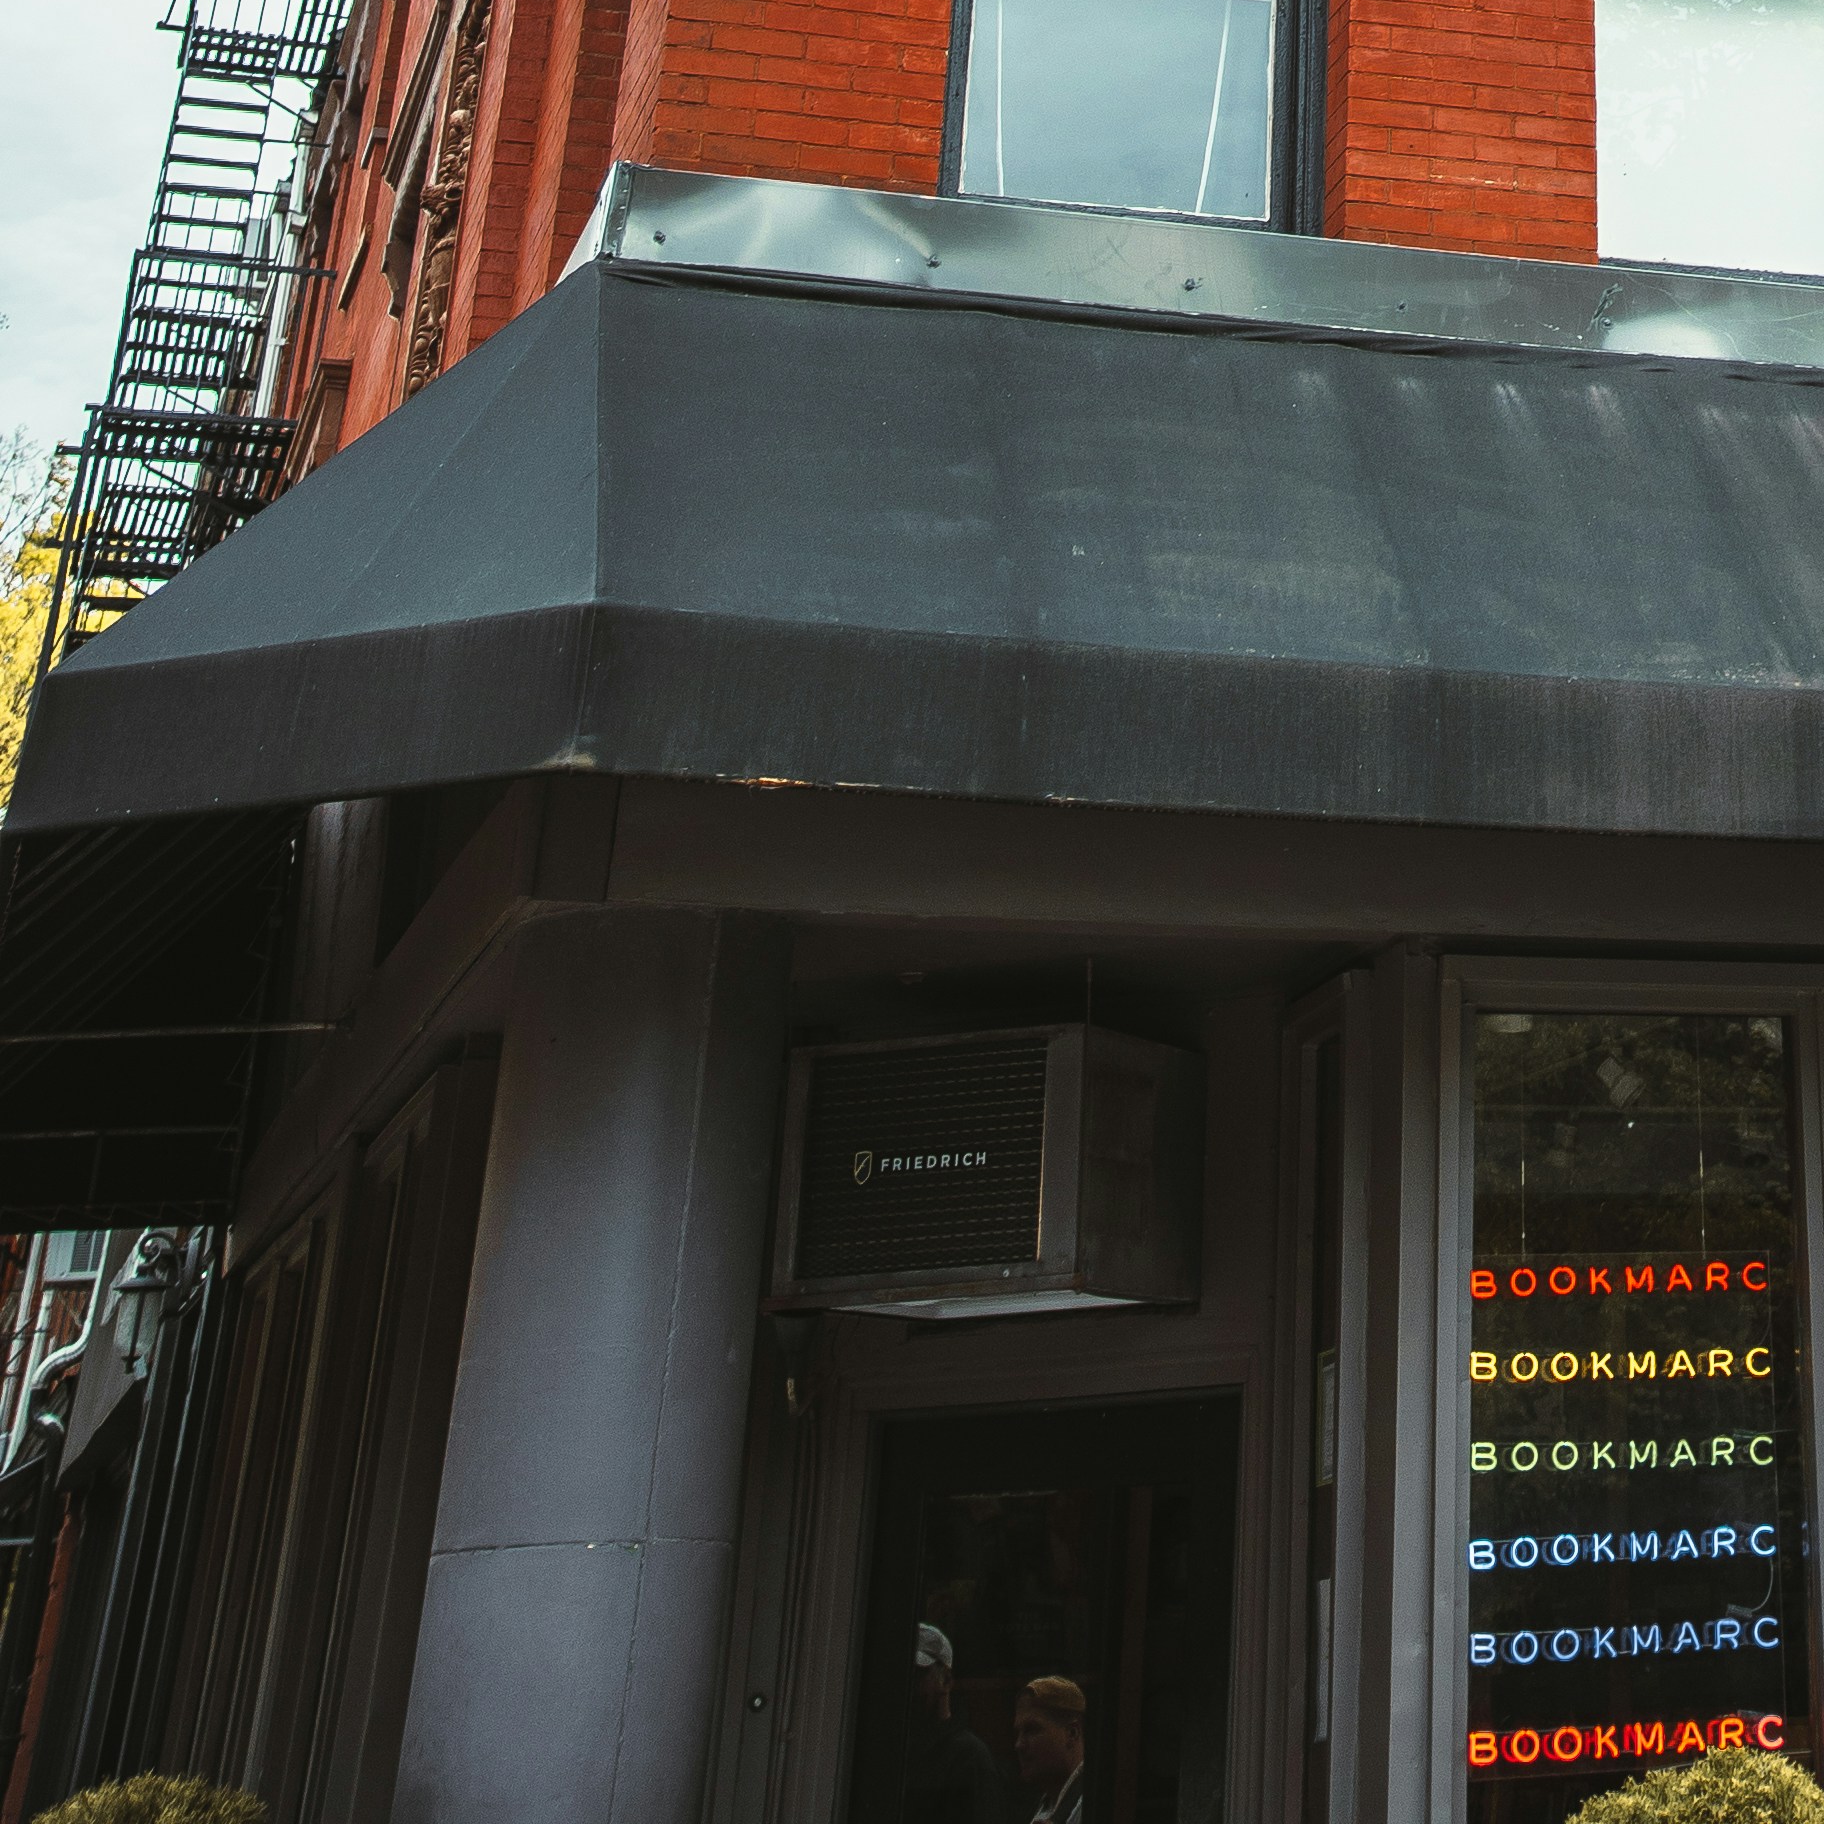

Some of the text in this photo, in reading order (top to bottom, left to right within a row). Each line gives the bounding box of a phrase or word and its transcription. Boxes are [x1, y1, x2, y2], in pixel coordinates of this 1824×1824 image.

[880, 1151, 987, 1173] FRIEDRICH
[1470, 1261, 1767, 1299] BOOKMARC
[1470, 1347, 1772, 1382] BOOKMARC
[1470, 1435, 1774, 1472] BOOKMARC
[1469, 1524, 1777, 1571] BOOKMARC
[1469, 1615, 1780, 1665] BOOKMARC
[1469, 1714, 1784, 1766] BOOKMARC
